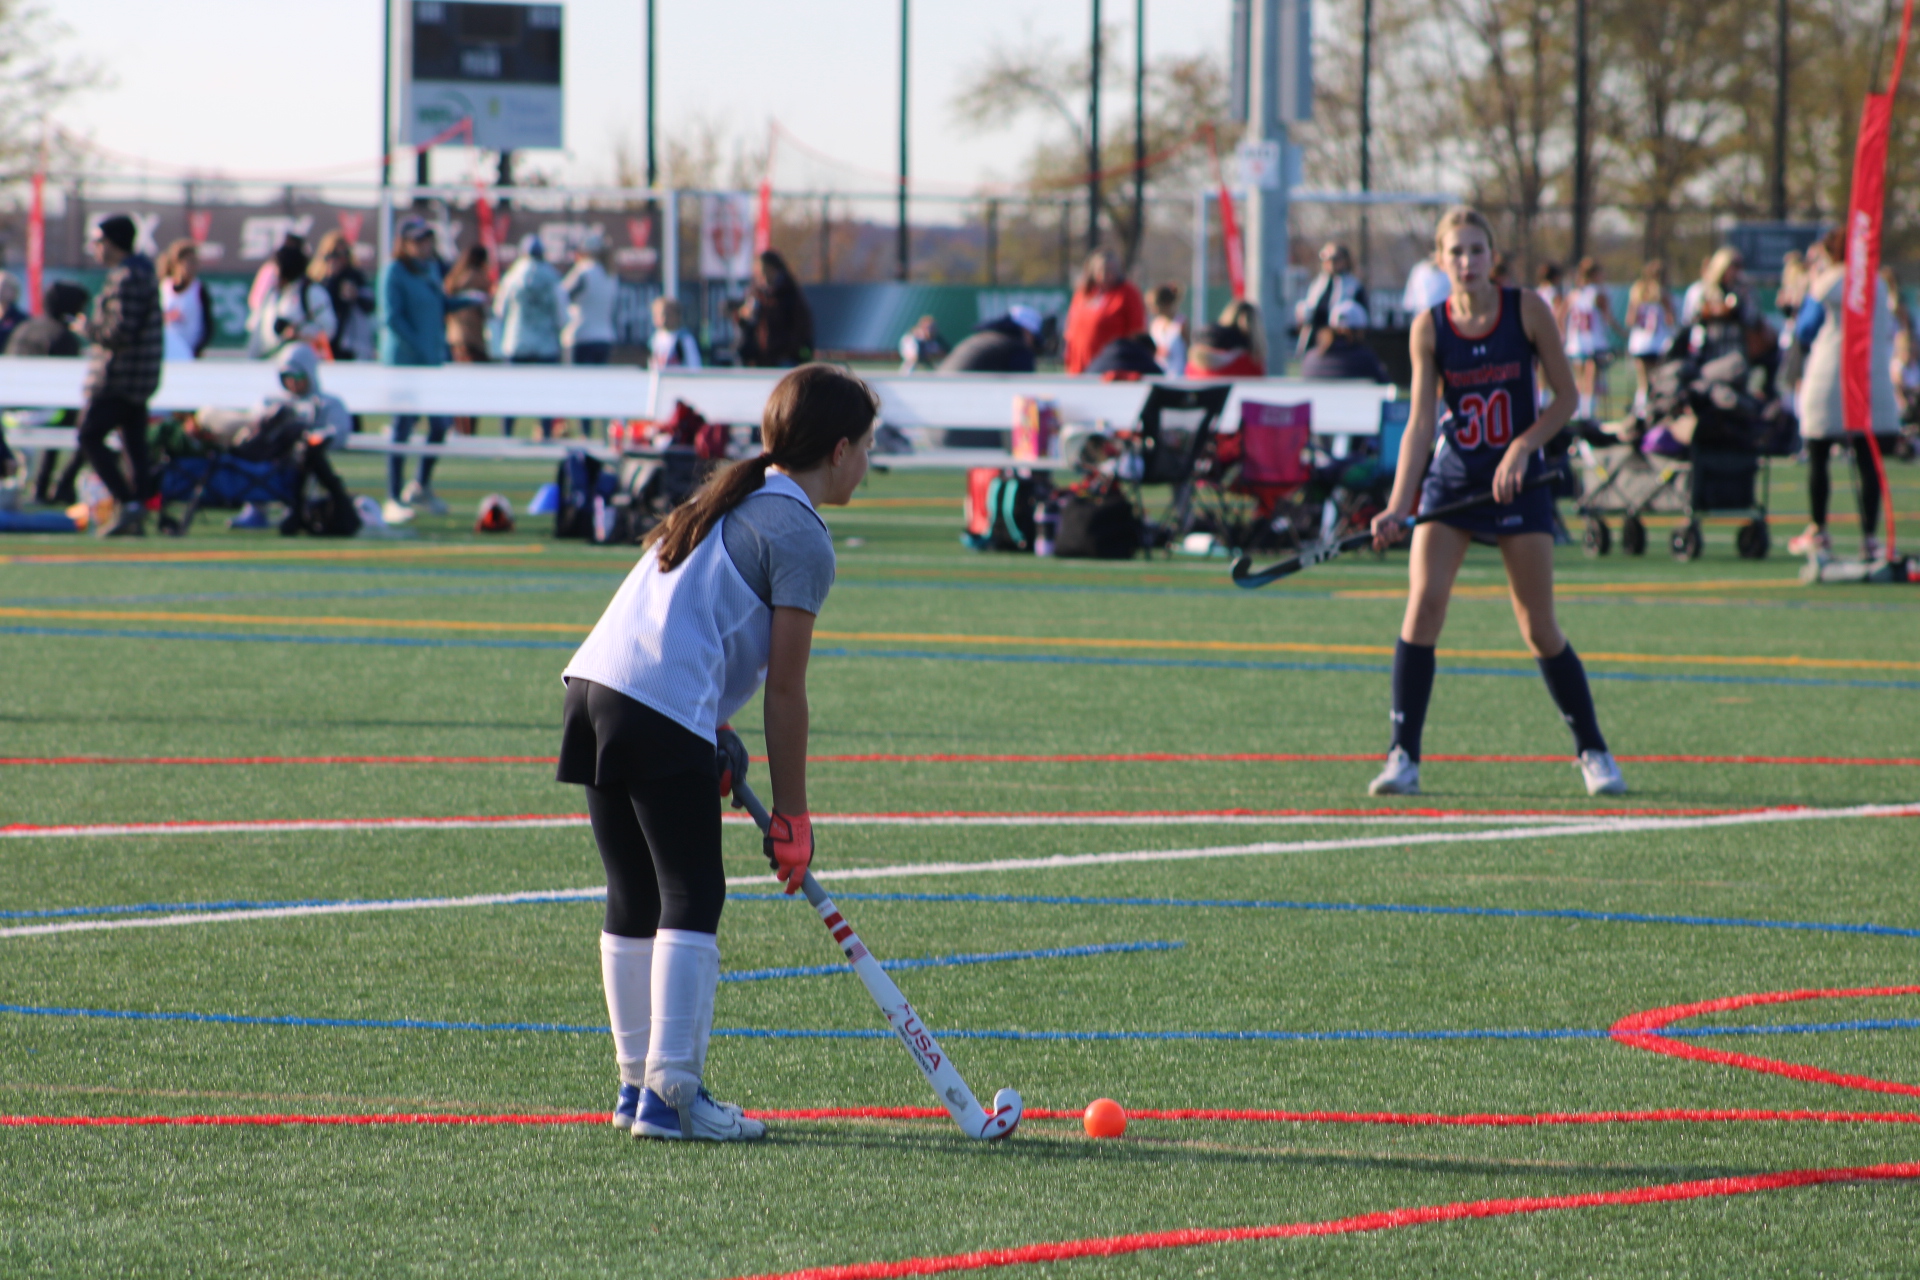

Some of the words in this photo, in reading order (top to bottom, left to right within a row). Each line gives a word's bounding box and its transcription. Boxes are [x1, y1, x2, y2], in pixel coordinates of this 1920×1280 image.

[84, 211, 159, 256] SX
[1454, 388, 1513, 450] 30
[904, 1017, 941, 1072] USA
